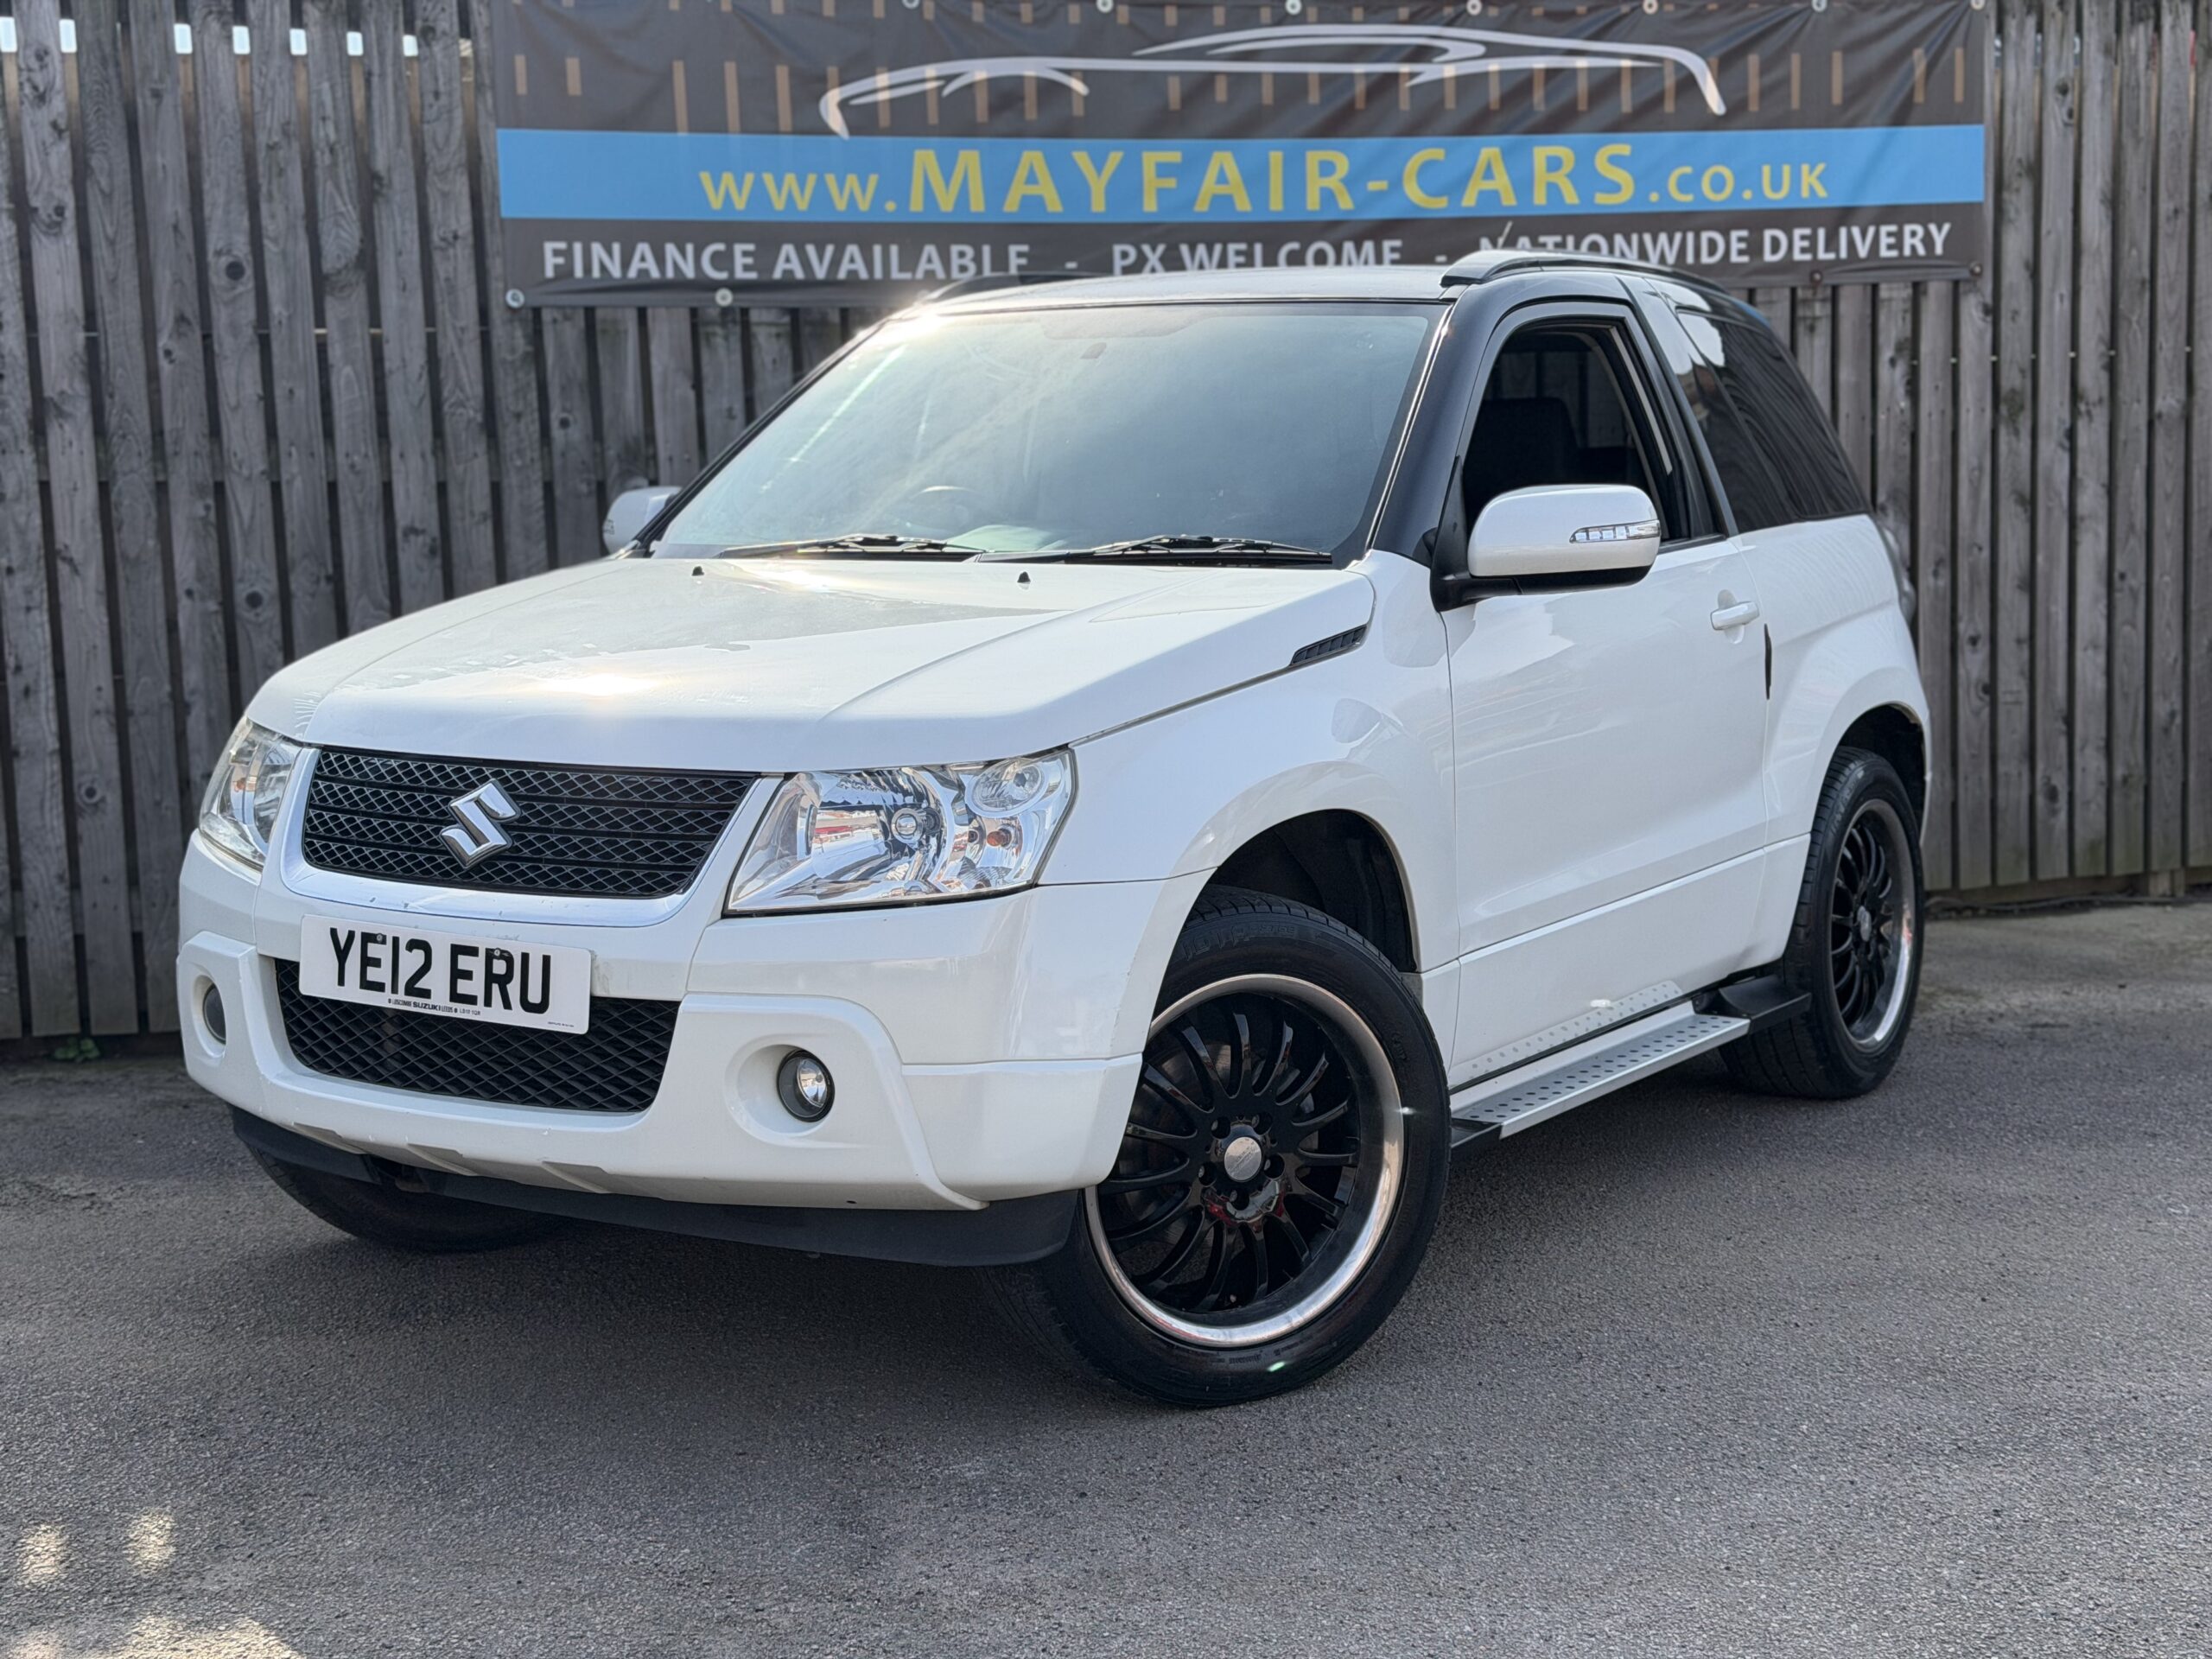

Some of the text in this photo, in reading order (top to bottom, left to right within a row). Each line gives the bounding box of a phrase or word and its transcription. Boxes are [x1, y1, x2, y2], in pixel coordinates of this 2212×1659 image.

[543, 241, 759, 280] FINANCE
[772, 243, 1029, 281] AVAILABLE
[1112, 244, 1166, 276] PX
[1179, 239, 1403, 270] WELCOME
[1763, 222, 1951, 263] DELIVERY
[329, 927, 551, 1015] YE12 ERU
[412, 1001, 442, 1012] SUZUKI
